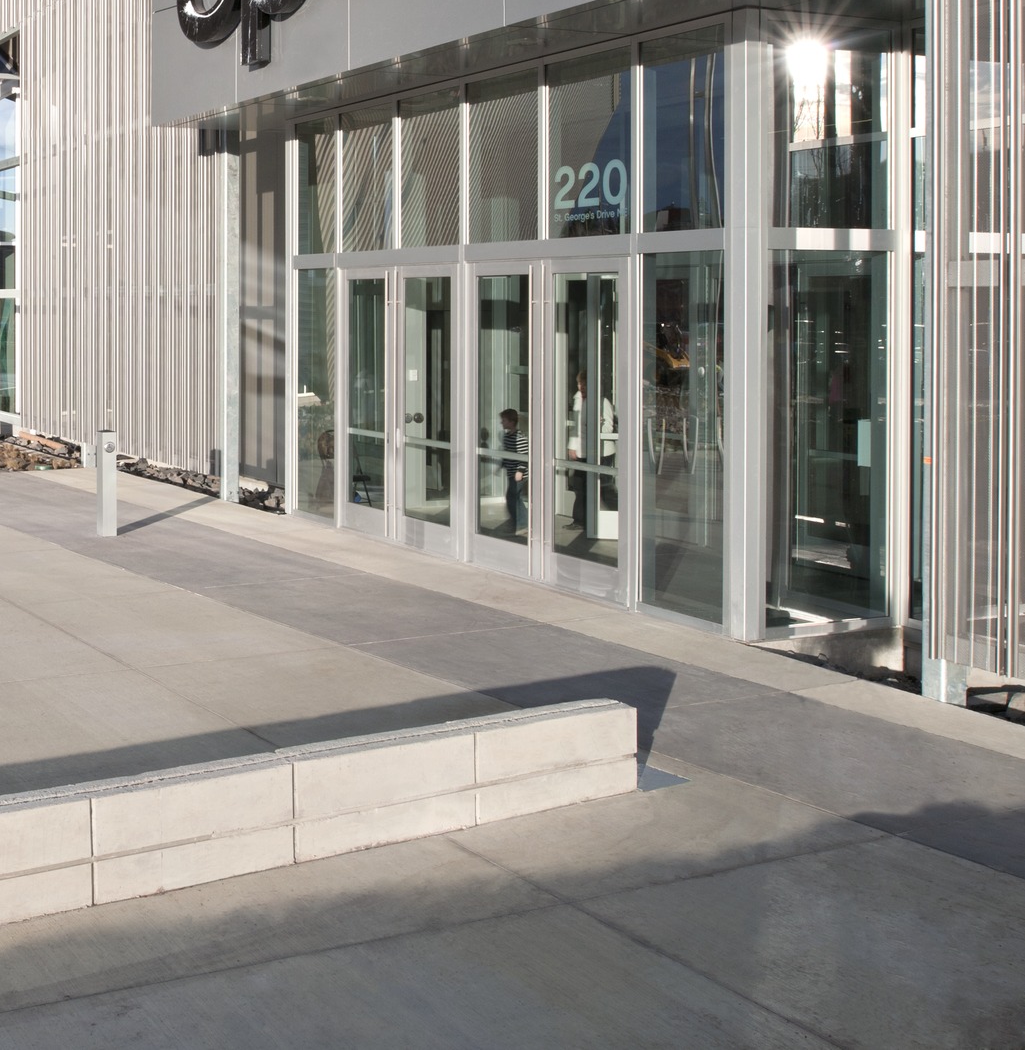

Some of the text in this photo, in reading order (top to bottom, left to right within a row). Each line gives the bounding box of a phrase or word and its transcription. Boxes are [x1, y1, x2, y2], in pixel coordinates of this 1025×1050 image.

[554, 159, 627, 210] 220
[554, 213, 563, 222] St.
[564, 211, 595, 222] George's
[596, 210, 615, 219] Drive
